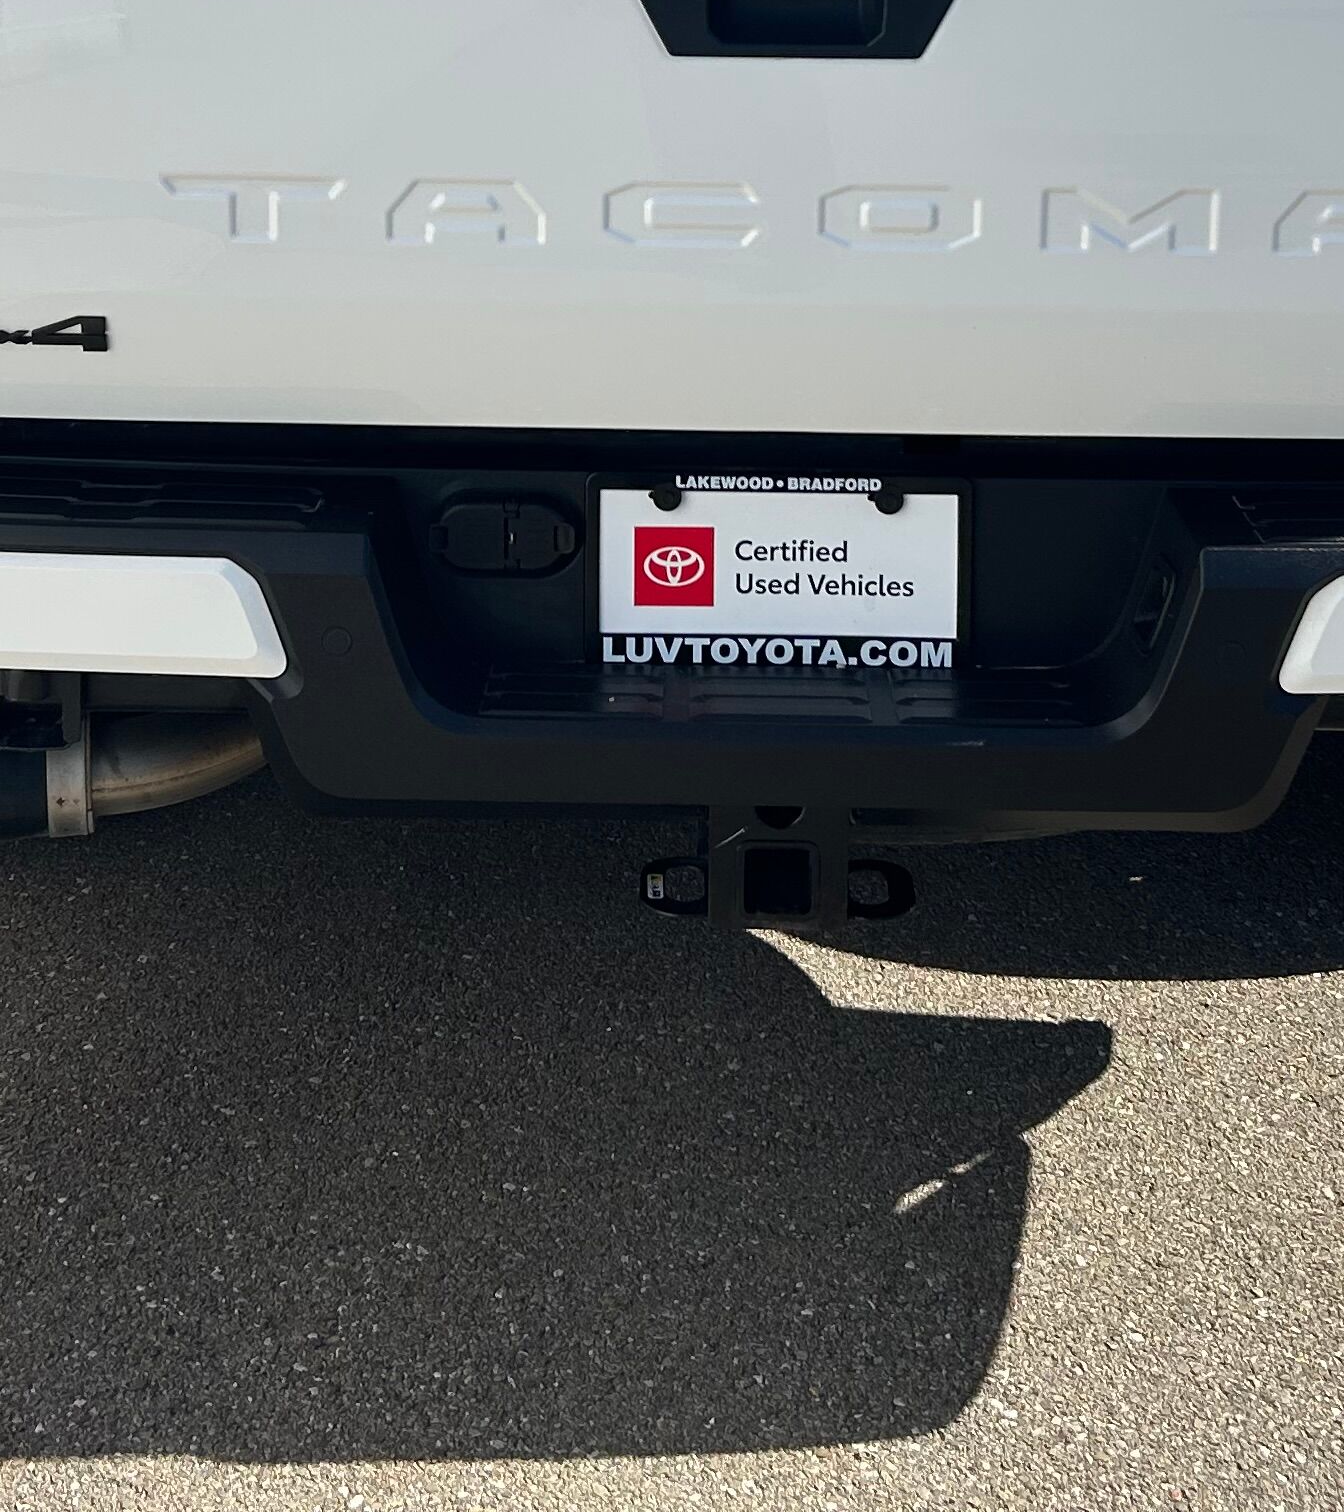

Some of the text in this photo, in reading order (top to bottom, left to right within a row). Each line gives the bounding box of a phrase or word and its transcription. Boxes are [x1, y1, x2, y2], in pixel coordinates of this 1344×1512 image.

[676, 475, 882, 492] LAKEWOOD BRADFORD
[734, 540, 849, 563] Certified
[735, 573, 914, 597] Used Vehicles
[602, 636, 953, 669] LUVTOYOTA.COM
